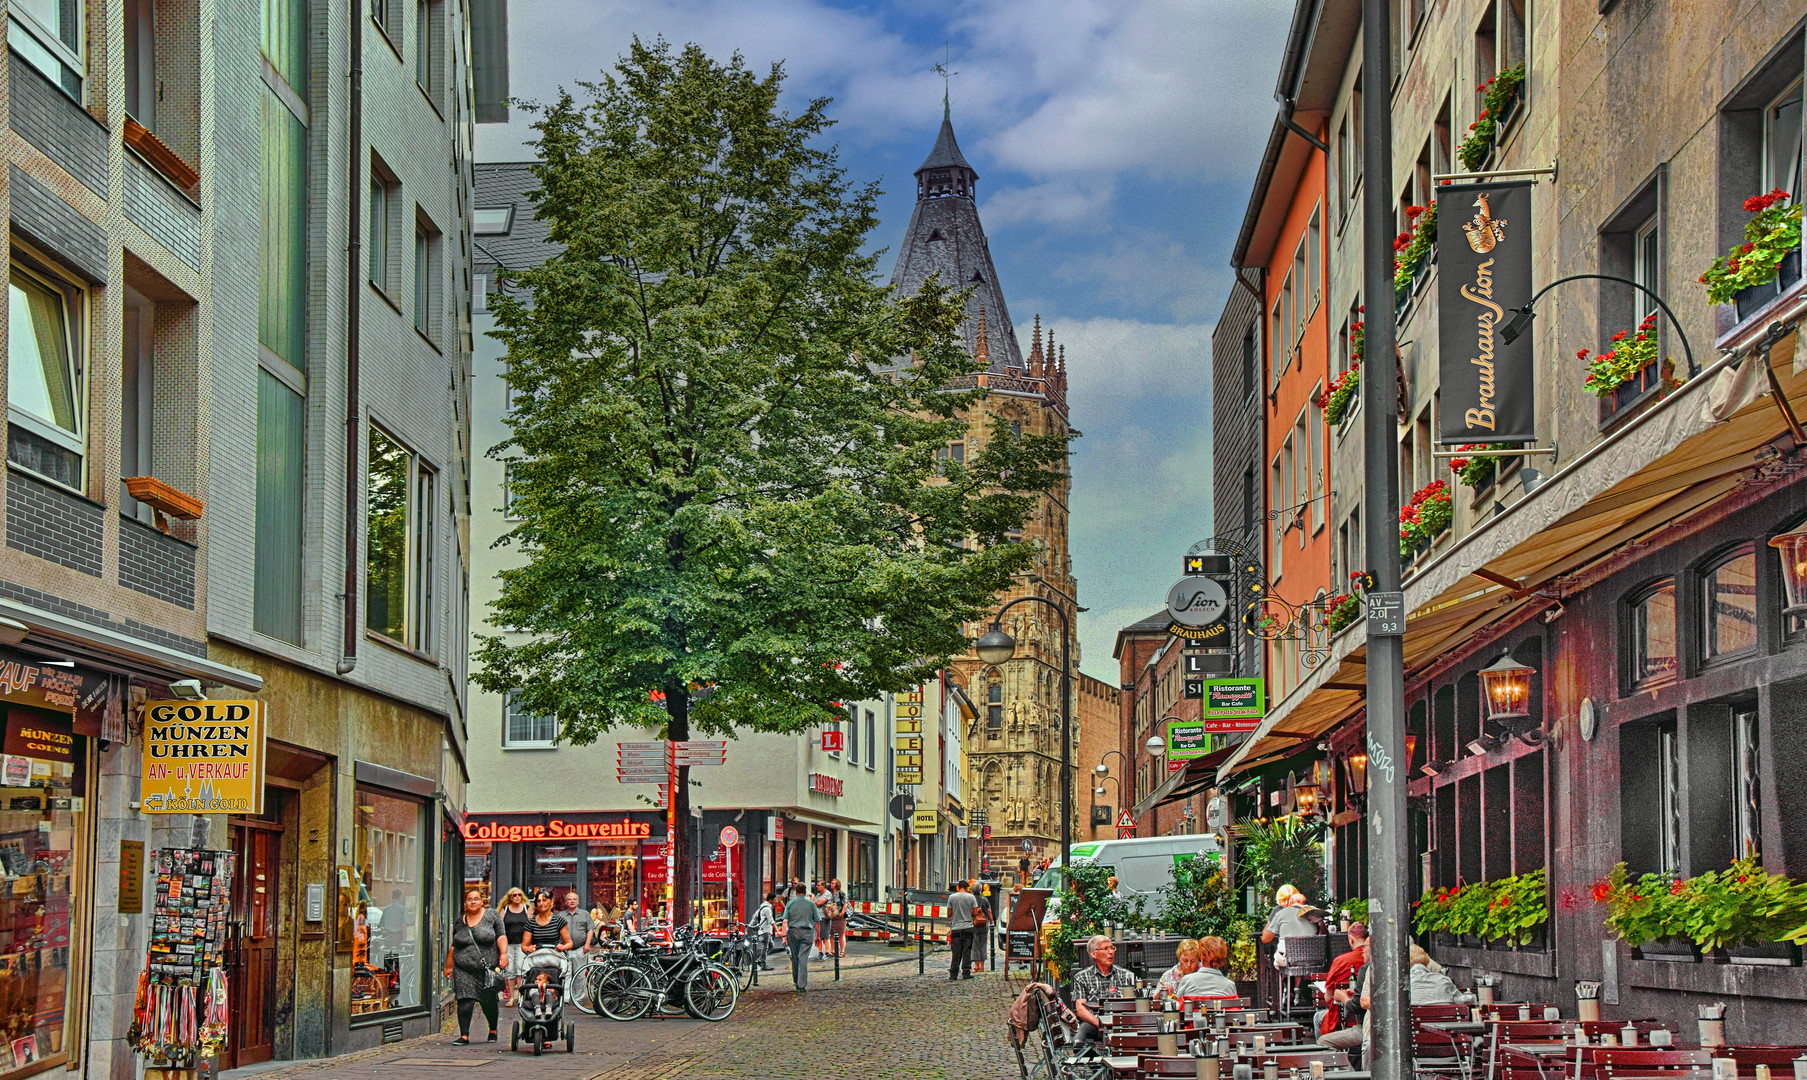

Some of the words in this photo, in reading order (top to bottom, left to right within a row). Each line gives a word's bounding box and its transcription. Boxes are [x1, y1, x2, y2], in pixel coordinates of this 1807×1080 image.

[1460, 257, 1504, 325] Sion
[1465, 311, 1496, 431] Brauhaus
[1174, 590, 1221, 613] Sion
[1369, 598, 1382, 607] AV
[1369, 610, 1385, 620] 2,0
[1169, 623, 1226, 640] BRAUHAUS
[1381, 622, 1397, 632] 9,3
[1188, 683, 1201, 694] SI
[150, 704, 251, 722] GOLD
[150, 722, 250, 741] MÜNZEN
[150, 743, 249, 758] UHREN
[149, 763, 173, 780] AN-
[167, 796, 206, 811] KÖLN
[209, 798, 248, 811] GOLD
[465, 821, 546, 842] Cologne
[549, 819, 650, 837] Souvenirs
